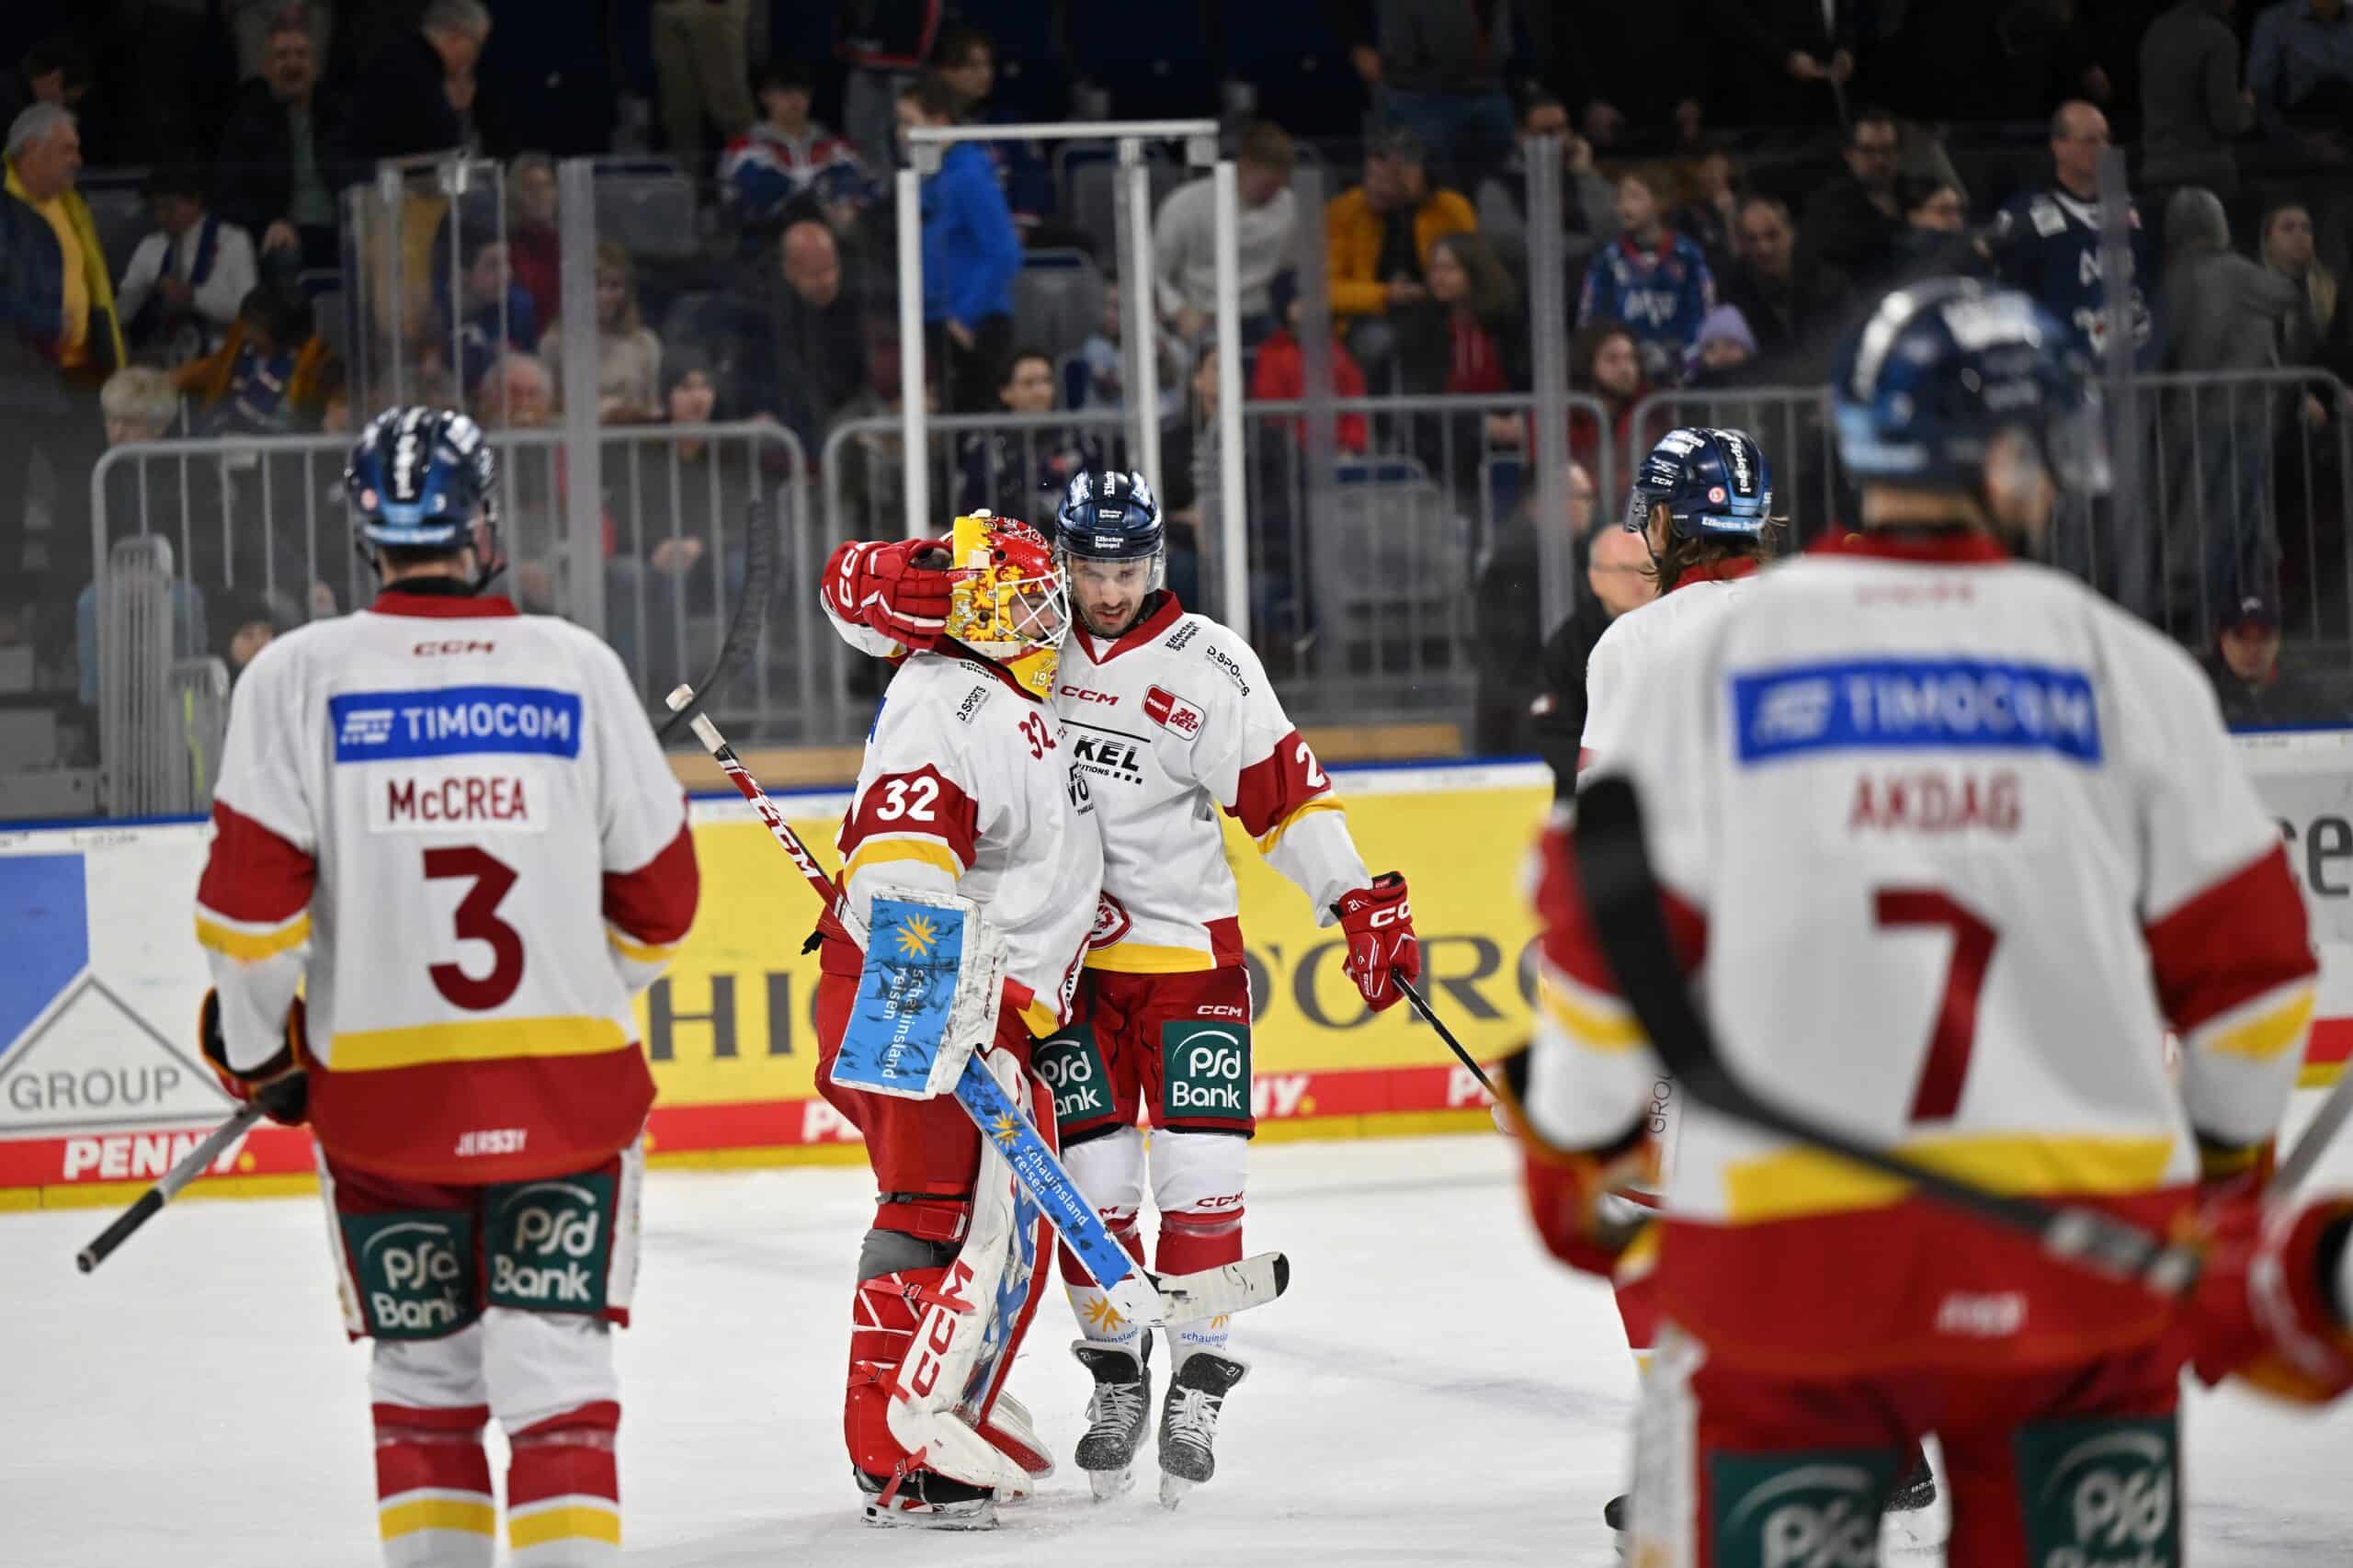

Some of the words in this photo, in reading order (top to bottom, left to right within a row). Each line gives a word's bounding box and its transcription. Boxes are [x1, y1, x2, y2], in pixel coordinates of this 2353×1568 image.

[413, 641, 494, 657] CCM
[1060, 684, 1120, 707] CCM
[401, 702, 571, 743] TIMOCOM
[1018, 710, 1057, 760] 32
[386, 777, 529, 823] McCREA
[876, 775, 939, 822] 32
[1847, 768, 2024, 837] AKDAG
[421, 846, 526, 1012] 3
[882, 967, 907, 1020] reisen
[1196, 1005, 1244, 1018] CCM
[1873, 887, 2001, 1122] 7
[881, 969, 924, 1080] schauinsland
[9, 1065, 180, 1111] GROUP
[1057, 1085, 1102, 1117] ank
[1172, 1081, 1242, 1110] Bank
[1015, 1153, 1047, 1196] reisen
[1023, 1144, 1090, 1227] schauinsland
[491, 1253, 592, 1302] Bank
[911, 1258, 975, 1398] CCM
